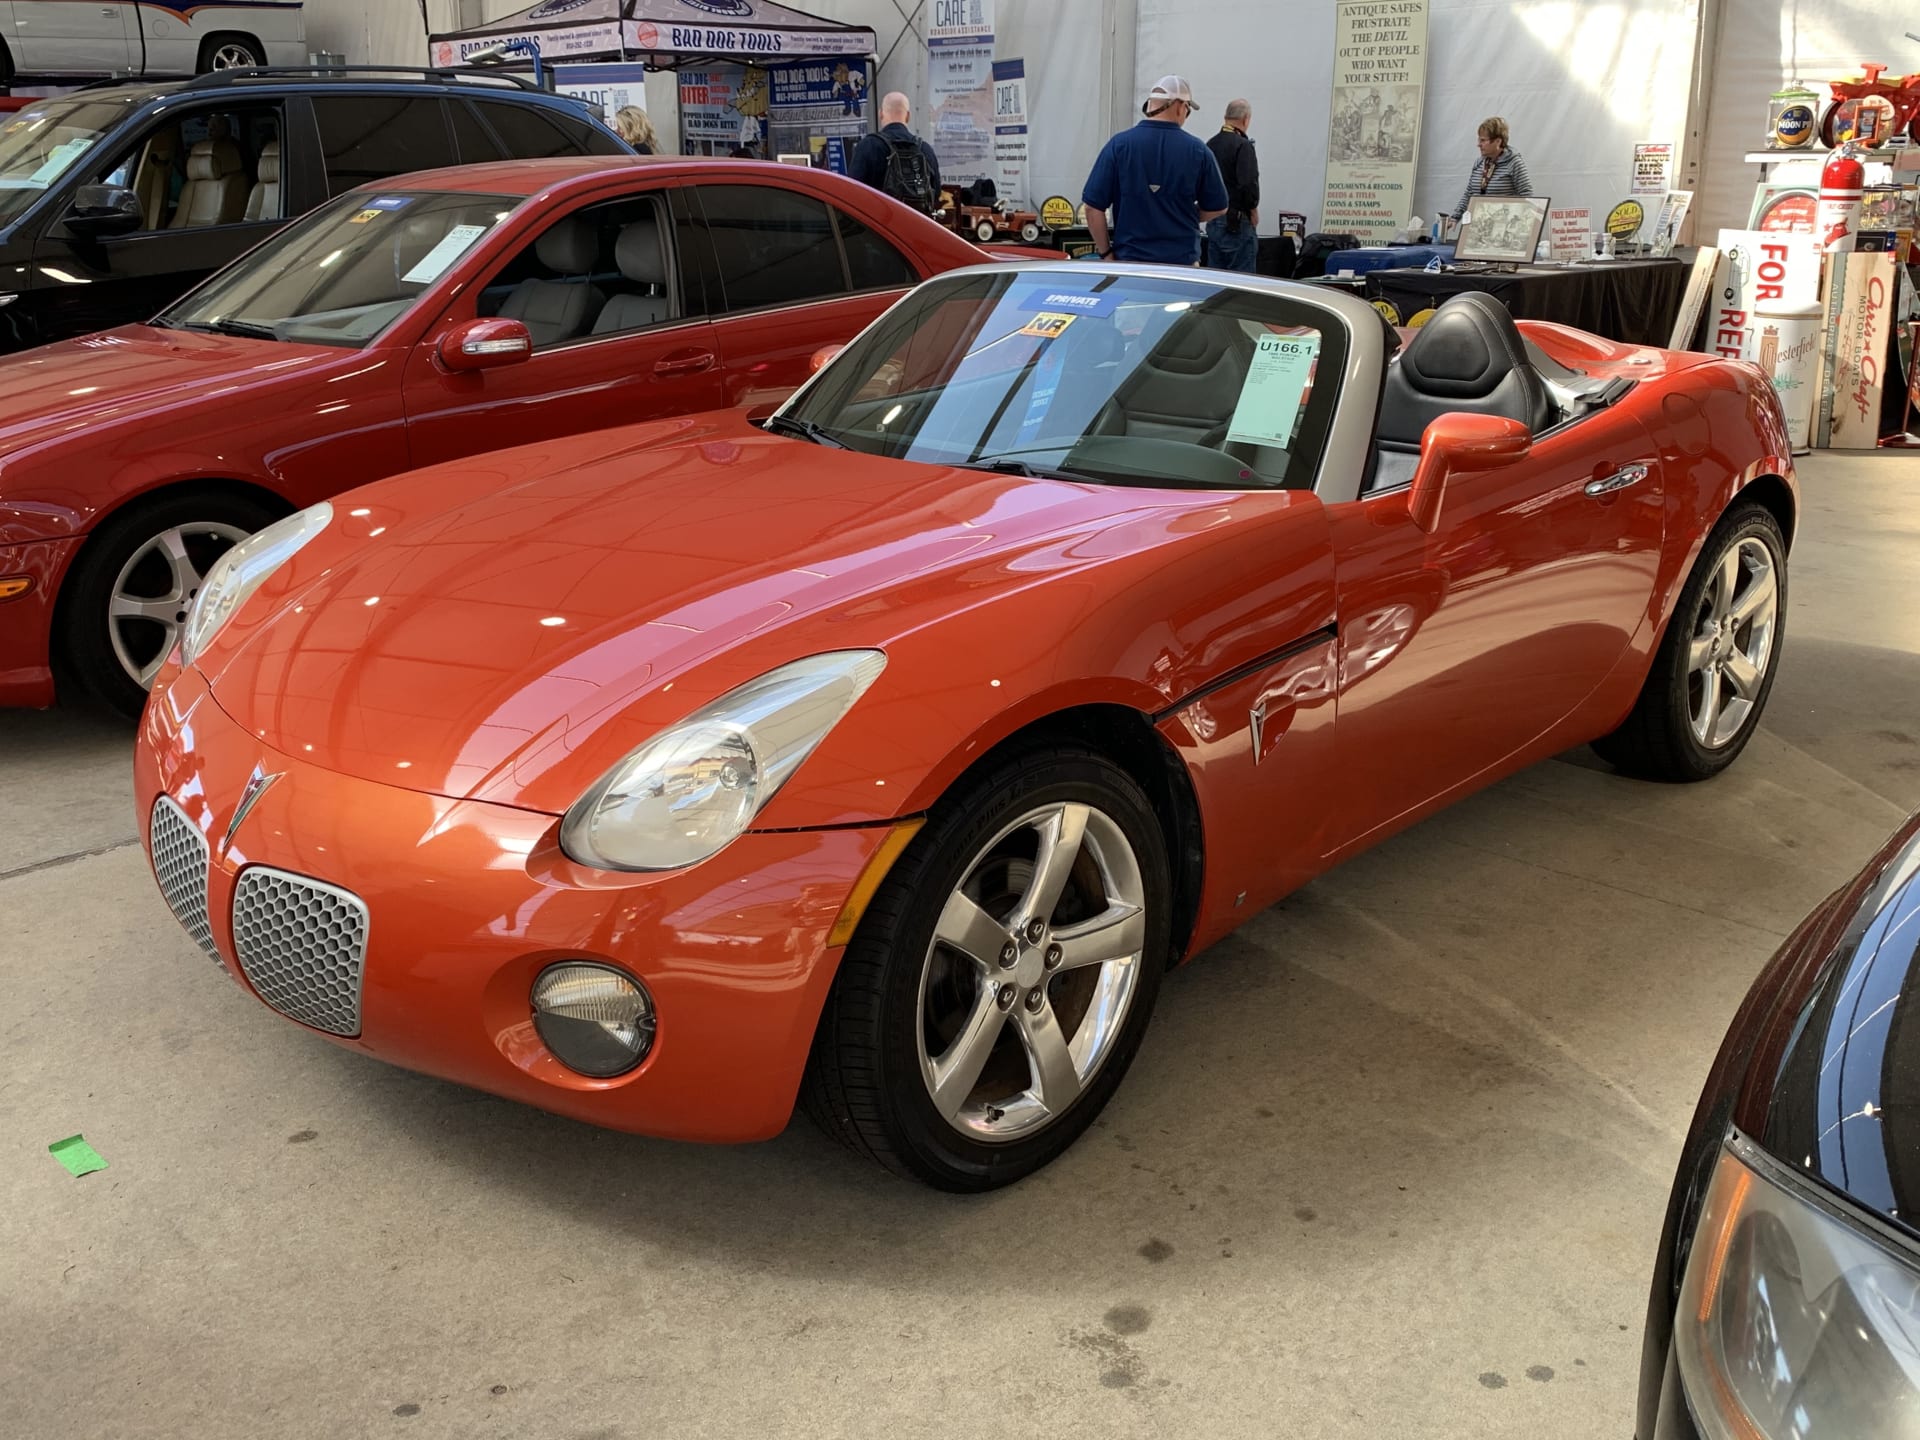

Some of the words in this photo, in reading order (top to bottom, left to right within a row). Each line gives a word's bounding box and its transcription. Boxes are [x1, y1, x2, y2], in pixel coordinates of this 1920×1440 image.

[936, 0, 966, 26] CARE
[1343, 5, 1388, 16] ANTIQUE
[1390, 3, 1422, 13] SAFES
[1352, 16, 1411, 29] FRUSTRATE
[930, 28, 957, 36] ROADSIDE
[958, 26, 992, 34] ASSISTANCE
[1352, 33, 1372, 43] THE
[1374, 30, 1408, 42] DEVIL
[672, 28, 702, 47] BAD
[706, 30, 735, 50] DOG
[740, 32, 782, 51] TOOLS
[1339, 47, 1360, 57] OUT
[1363, 46, 1376, 56] OF
[1378, 45, 1420, 56] PEOPLE
[1352, 60, 1374, 70] WHO
[1377, 59, 1407, 69] WANT
[789, 68, 805, 83] DOG
[806, 67, 830, 82] TOOLS
[1344, 73, 1371, 84] YOUR
[1373, 72, 1409, 82] STUFF!
[681, 86, 709, 104] BITER
[996, 86, 1012, 115] CARE
[1778, 120, 1800, 128] MOON
[1634, 154, 1670, 162] ANTIQUE
[1048, 202, 1068, 210] SOLD
[1615, 206, 1638, 218] SOLD
[1551, 211, 1565, 219] FREE
[1566, 210, 1589, 218] DELIVERY
[1755, 244, 1789, 302] FOR
[1863, 276, 1885, 338] Chris
[1825, 283, 1838, 360] AUTHORIZED
[1856, 295, 1866, 339] MOTOR
[1260, 342, 1312, 355] U166.1
[1851, 346, 1862, 386] BOATS
[1820, 370, 1830, 416] DEALER
[1852, 354, 1877, 423] Craft
